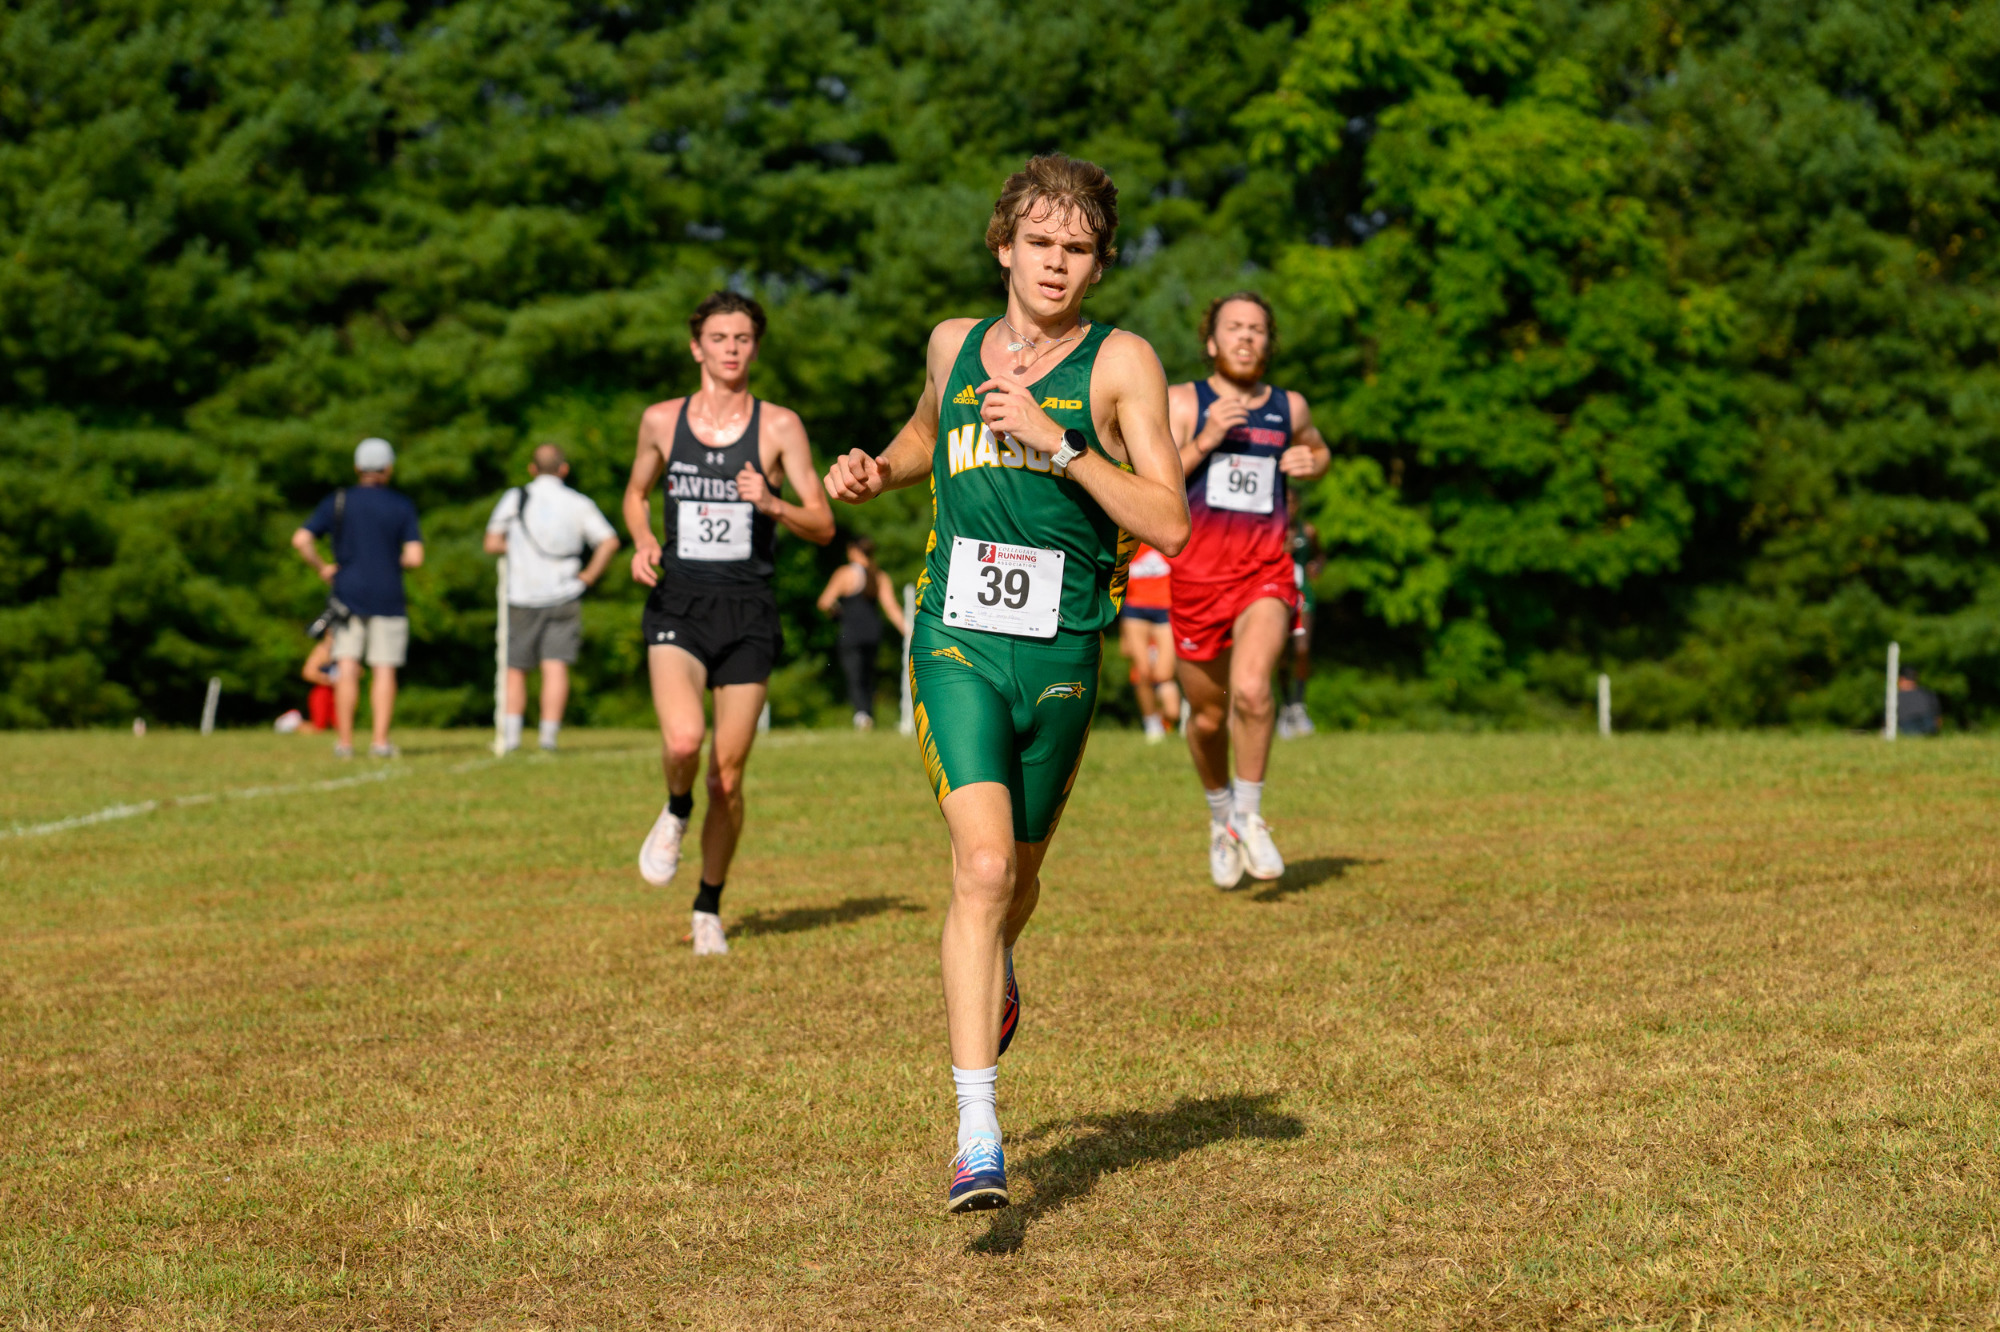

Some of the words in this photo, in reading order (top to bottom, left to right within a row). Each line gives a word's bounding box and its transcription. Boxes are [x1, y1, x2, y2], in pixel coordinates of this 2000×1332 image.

[953, 396, 979, 406] adidas
[948, 422, 1076, 480] MASO
[668, 475, 738, 500] DAVIDS
[1228, 469, 1258, 495] 96
[699, 518, 731, 543] 32
[998, 552, 1037, 562] RUNNING
[977, 565, 1030, 609] 39
